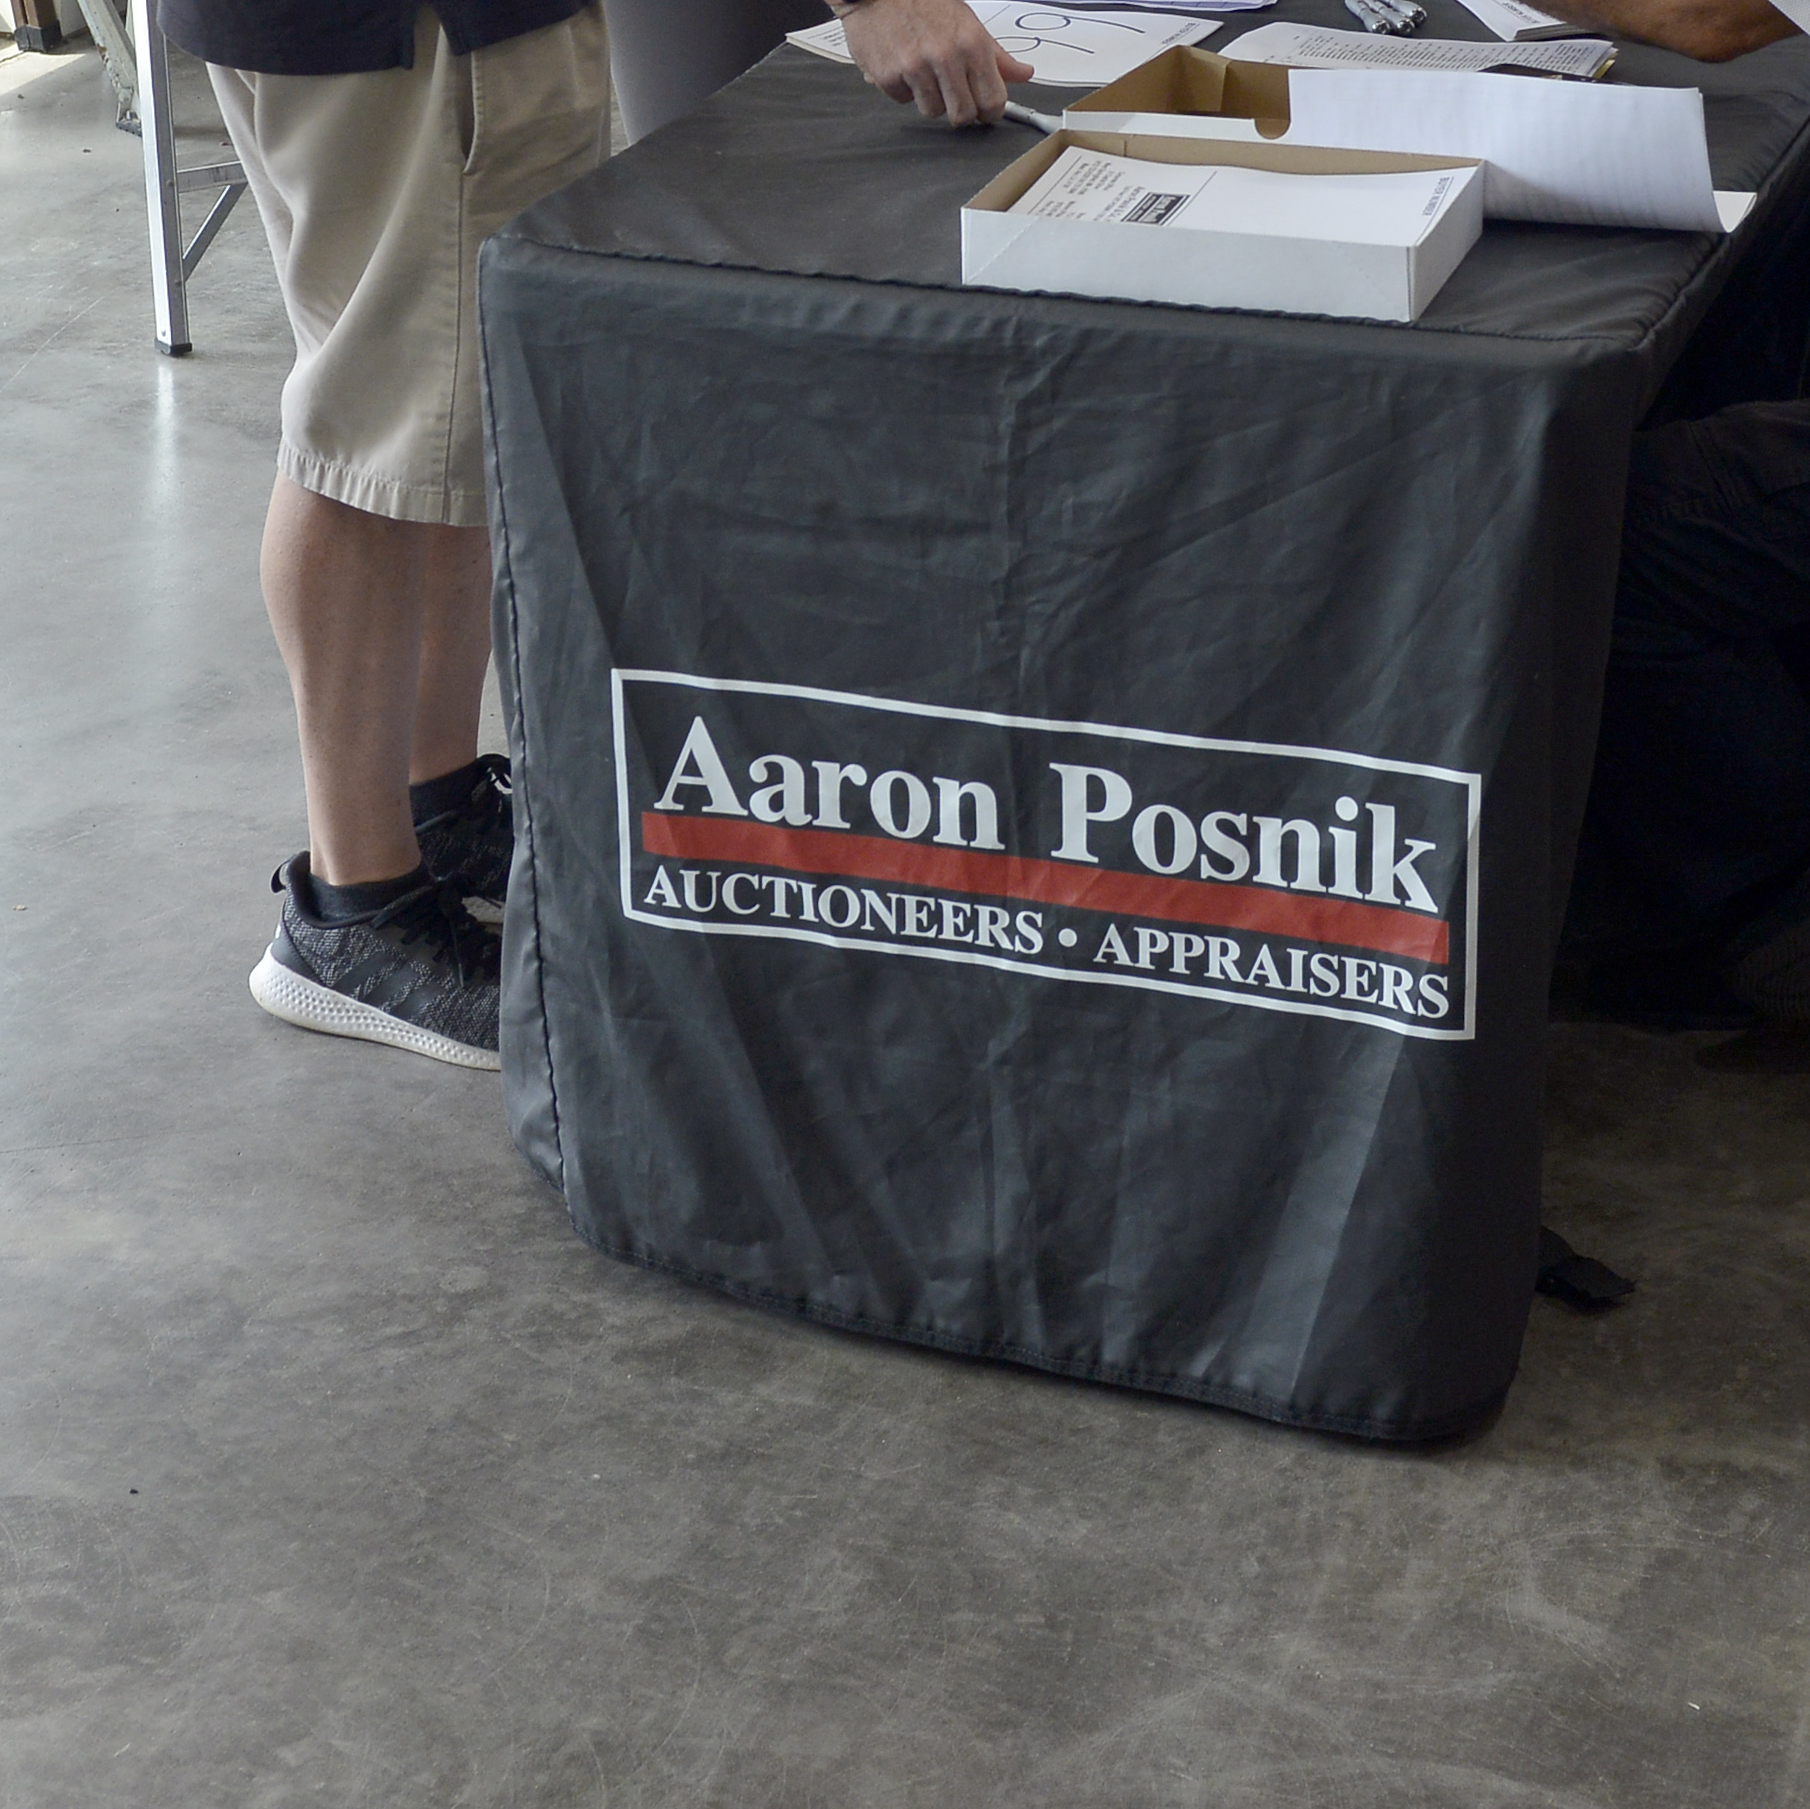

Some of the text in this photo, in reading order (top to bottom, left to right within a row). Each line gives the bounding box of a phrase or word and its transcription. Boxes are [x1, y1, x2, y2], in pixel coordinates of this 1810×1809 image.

[653, 716, 1440, 916] Aaron Posnik
[643, 864, 1450, 1021] AUCTIONEERS APPRAISERS
